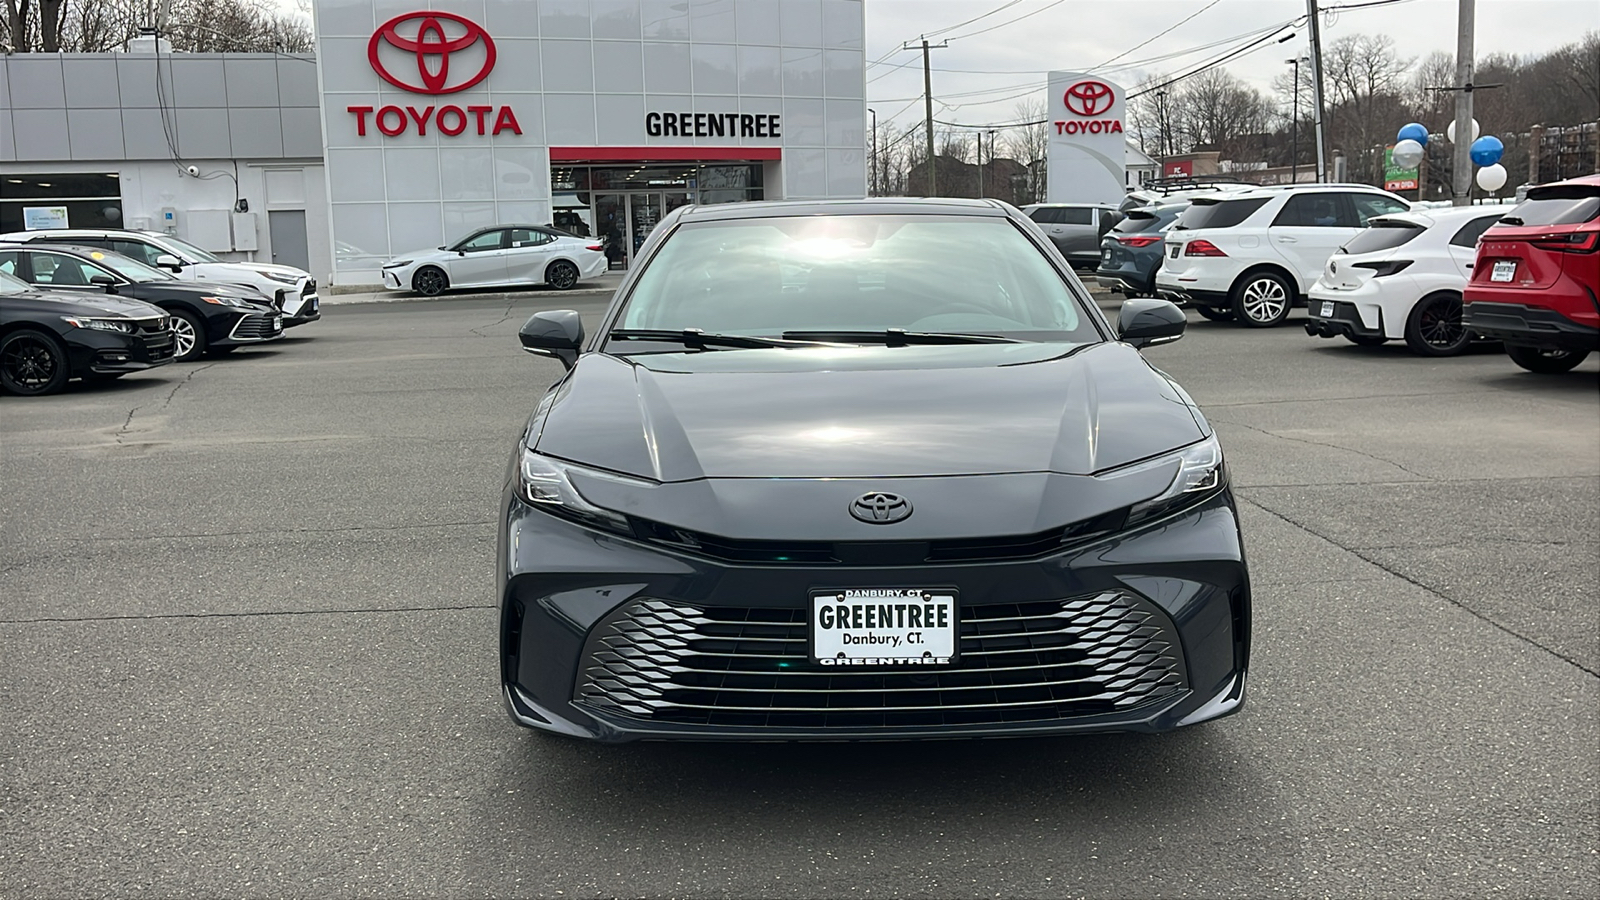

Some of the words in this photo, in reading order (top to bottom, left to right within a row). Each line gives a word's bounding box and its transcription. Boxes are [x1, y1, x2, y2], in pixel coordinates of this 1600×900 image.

[347, 105, 523, 137] TOYOTA
[646, 112, 781, 138] GREENTREE
[1054, 120, 1123, 135] TOYOTA
[845, 589, 904, 598] DANBURY,
[907, 589, 923, 597] CT
[819, 604, 948, 629] GREENTREE
[843, 632, 903, 647] Danbury,
[907, 632, 925, 644] CT.
[820, 657, 950, 666] GREENTREE
